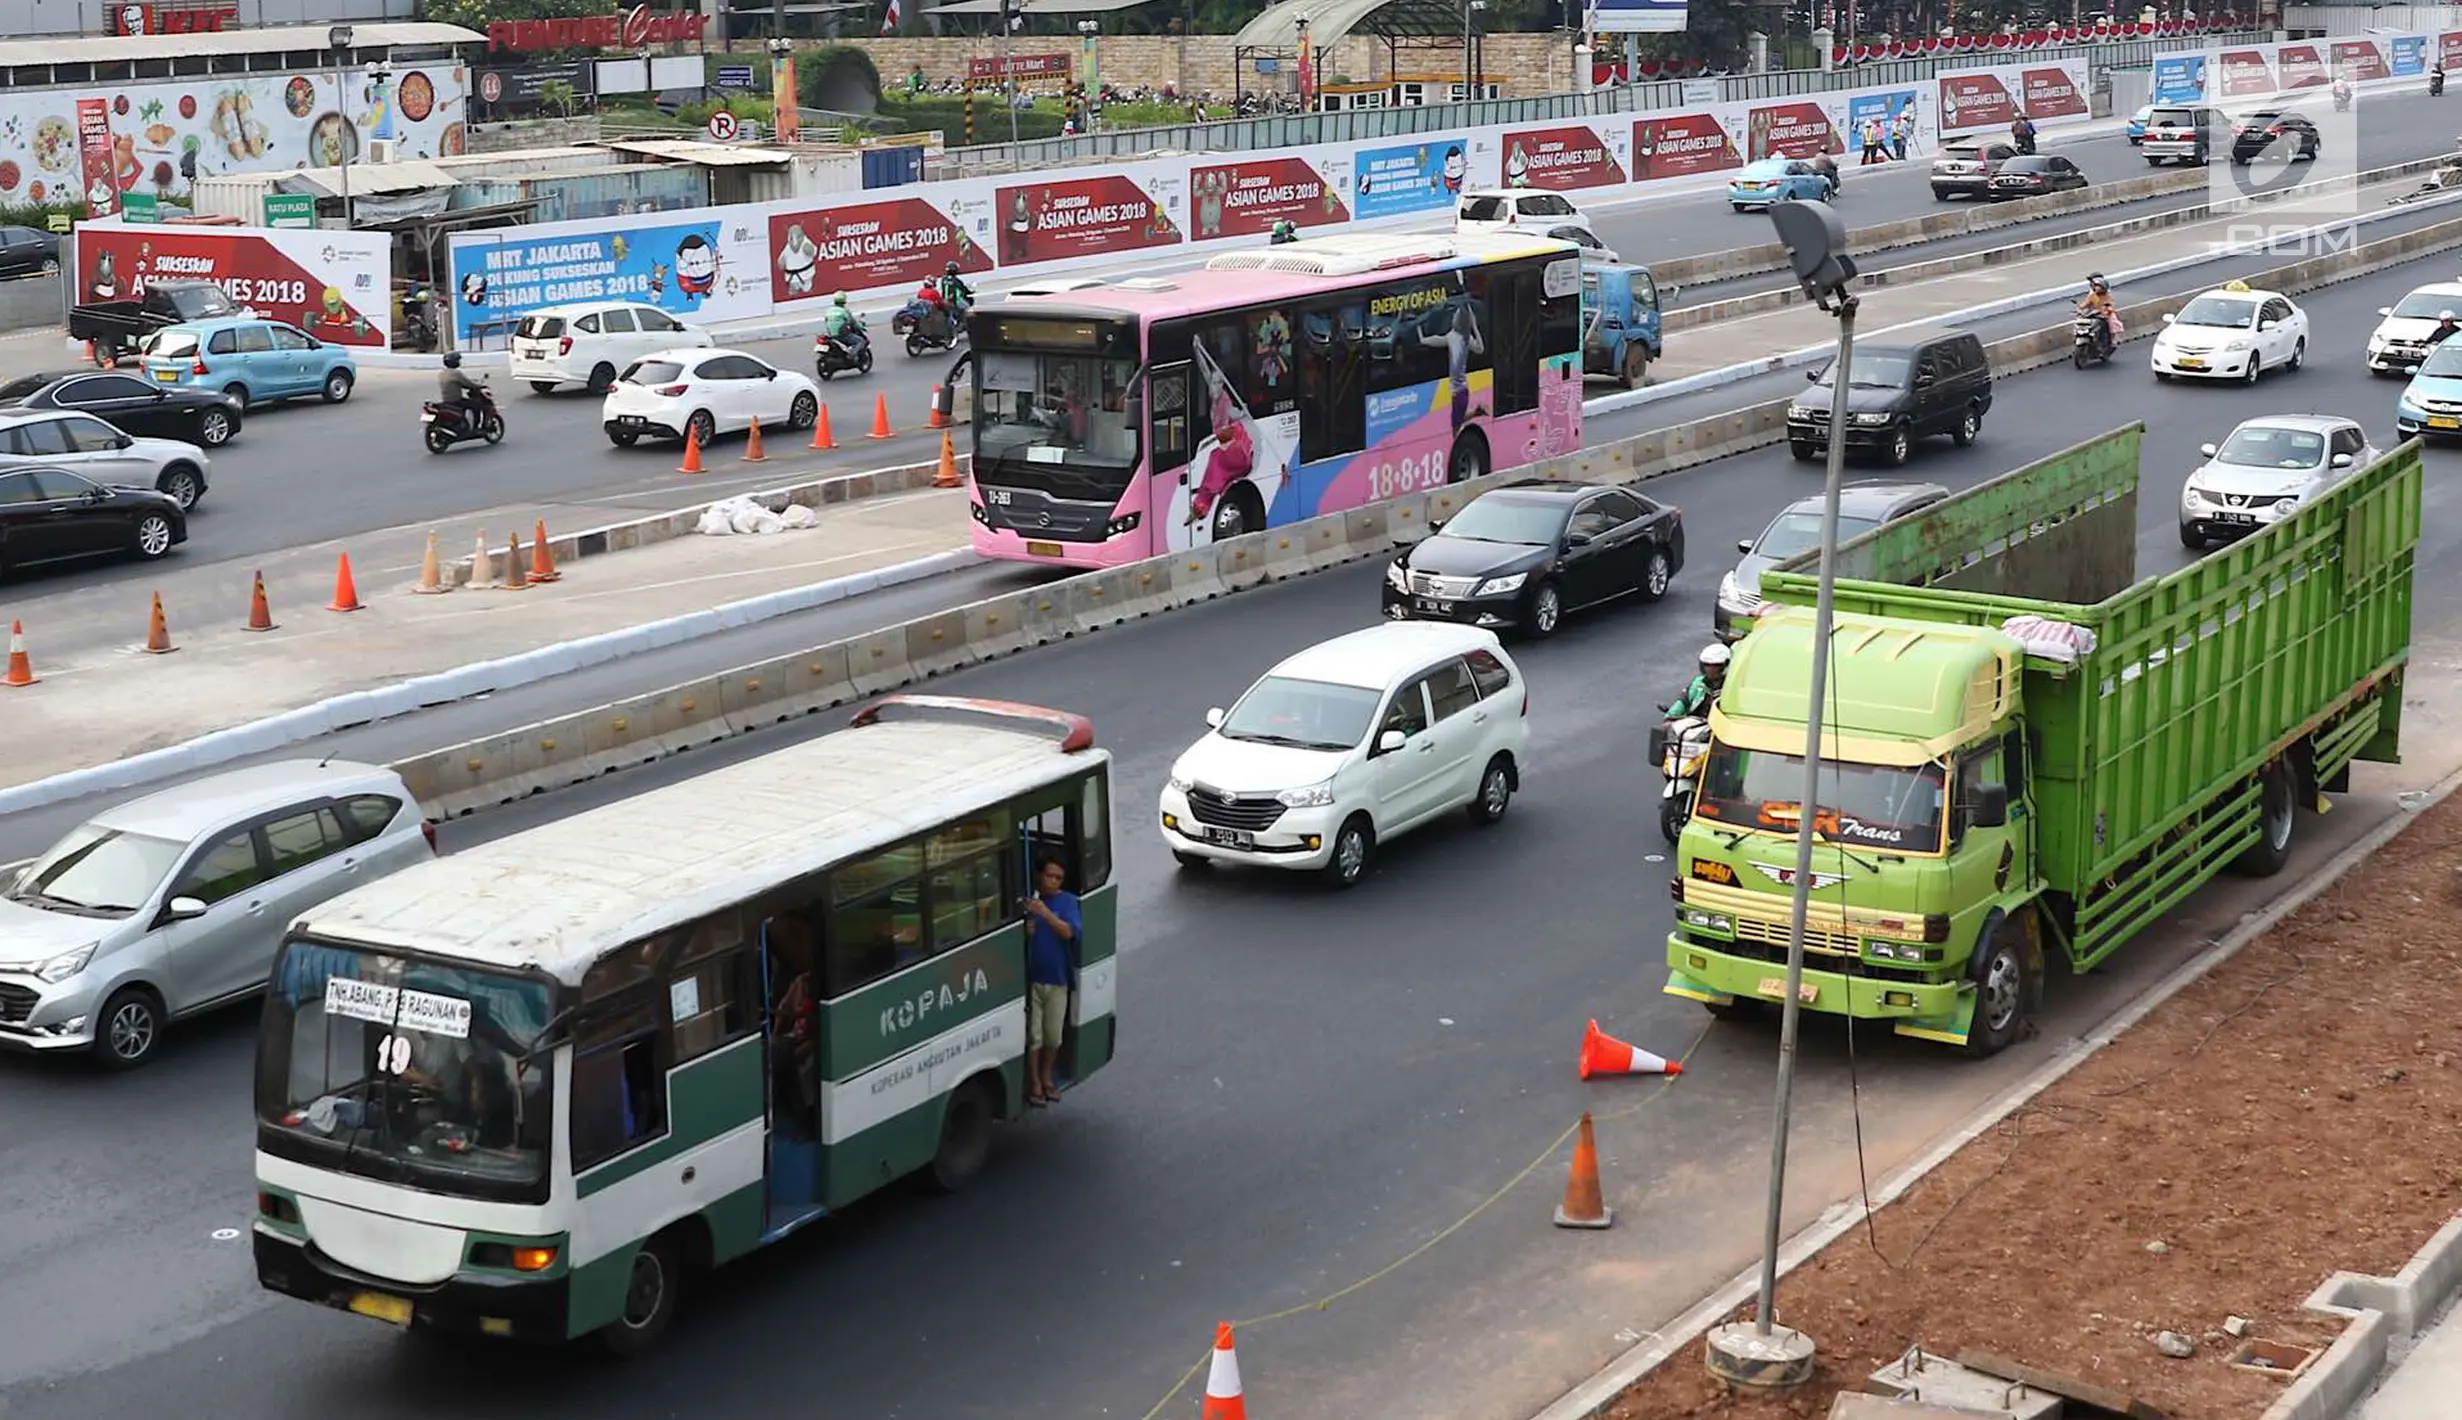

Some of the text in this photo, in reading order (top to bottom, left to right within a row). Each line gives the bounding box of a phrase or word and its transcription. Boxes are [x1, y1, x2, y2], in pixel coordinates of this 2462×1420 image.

[622, 3, 711, 48] Center
[1554, 150, 1582, 166] GAMES
[1225, 182, 1319, 208] ASIAN GAMES 2018
[1037, 201, 1147, 230] ASIAN GAMES 2018
[486, 241, 602, 269] MRT JAKARTA
[818, 226, 948, 261] ASIAN GAMES 2018
[155, 255, 215, 274] SUKSESKAN
[542, 260, 616, 280] SUKSESKAN
[255, 279, 306, 303] 2018
[545, 279, 603, 301] GAMES
[606, 273, 649, 295] 2018
[1371, 286, 1448, 316] ENERGY OF ASIA
[1841, 816, 1902, 843] Trans
[408, 995, 458, 1021] RAGUNAN
[880, 967, 988, 1038] KOPAJA
[871, 1026, 1002, 1095] KOPERASI ANGKUTAN JAKARTA
